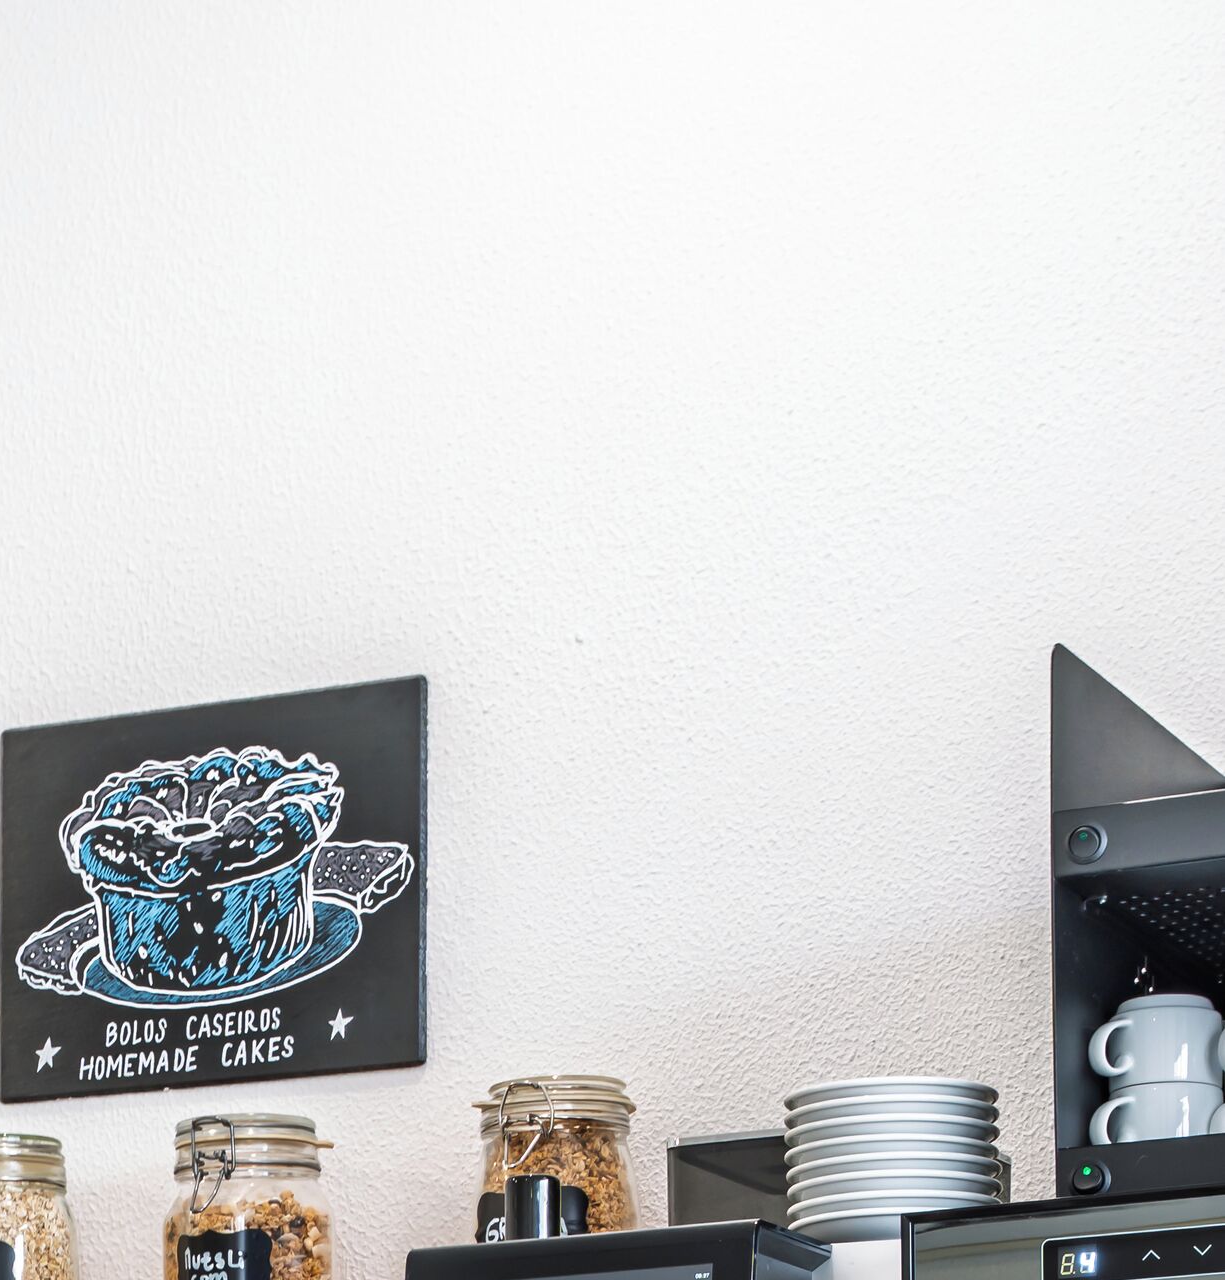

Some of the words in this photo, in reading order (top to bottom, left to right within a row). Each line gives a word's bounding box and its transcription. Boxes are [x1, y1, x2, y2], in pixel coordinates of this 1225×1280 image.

[105, 1017, 168, 1047] BOLOS
[185, 1006, 281, 1041] CASEIROS
[78, 1045, 199, 1081] HOMEMADE
[221, 1035, 295, 1067] CAKES
